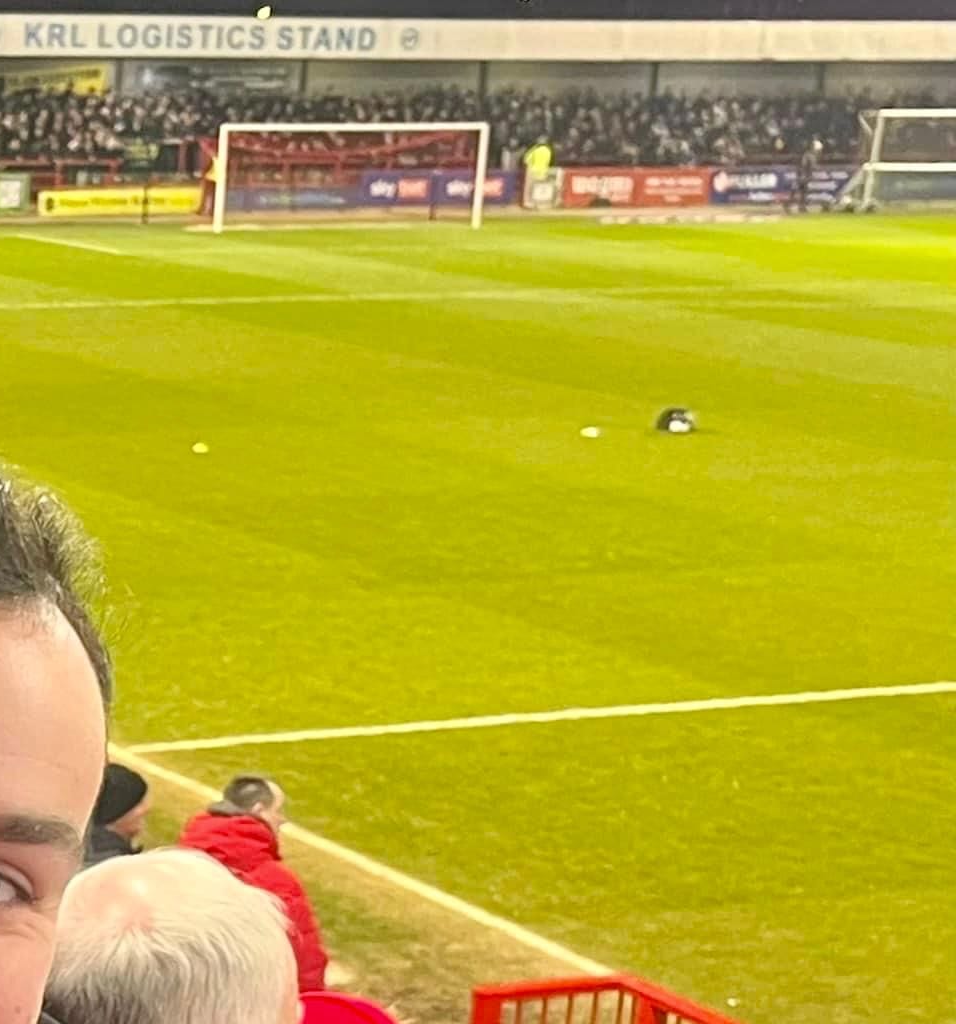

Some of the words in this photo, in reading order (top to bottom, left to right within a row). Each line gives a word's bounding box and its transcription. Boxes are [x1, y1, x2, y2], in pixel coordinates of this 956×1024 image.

[23, 22, 88, 48] KRL
[97, 23, 267, 50] LOGISTICS
[276, 26, 376, 51] STAND
